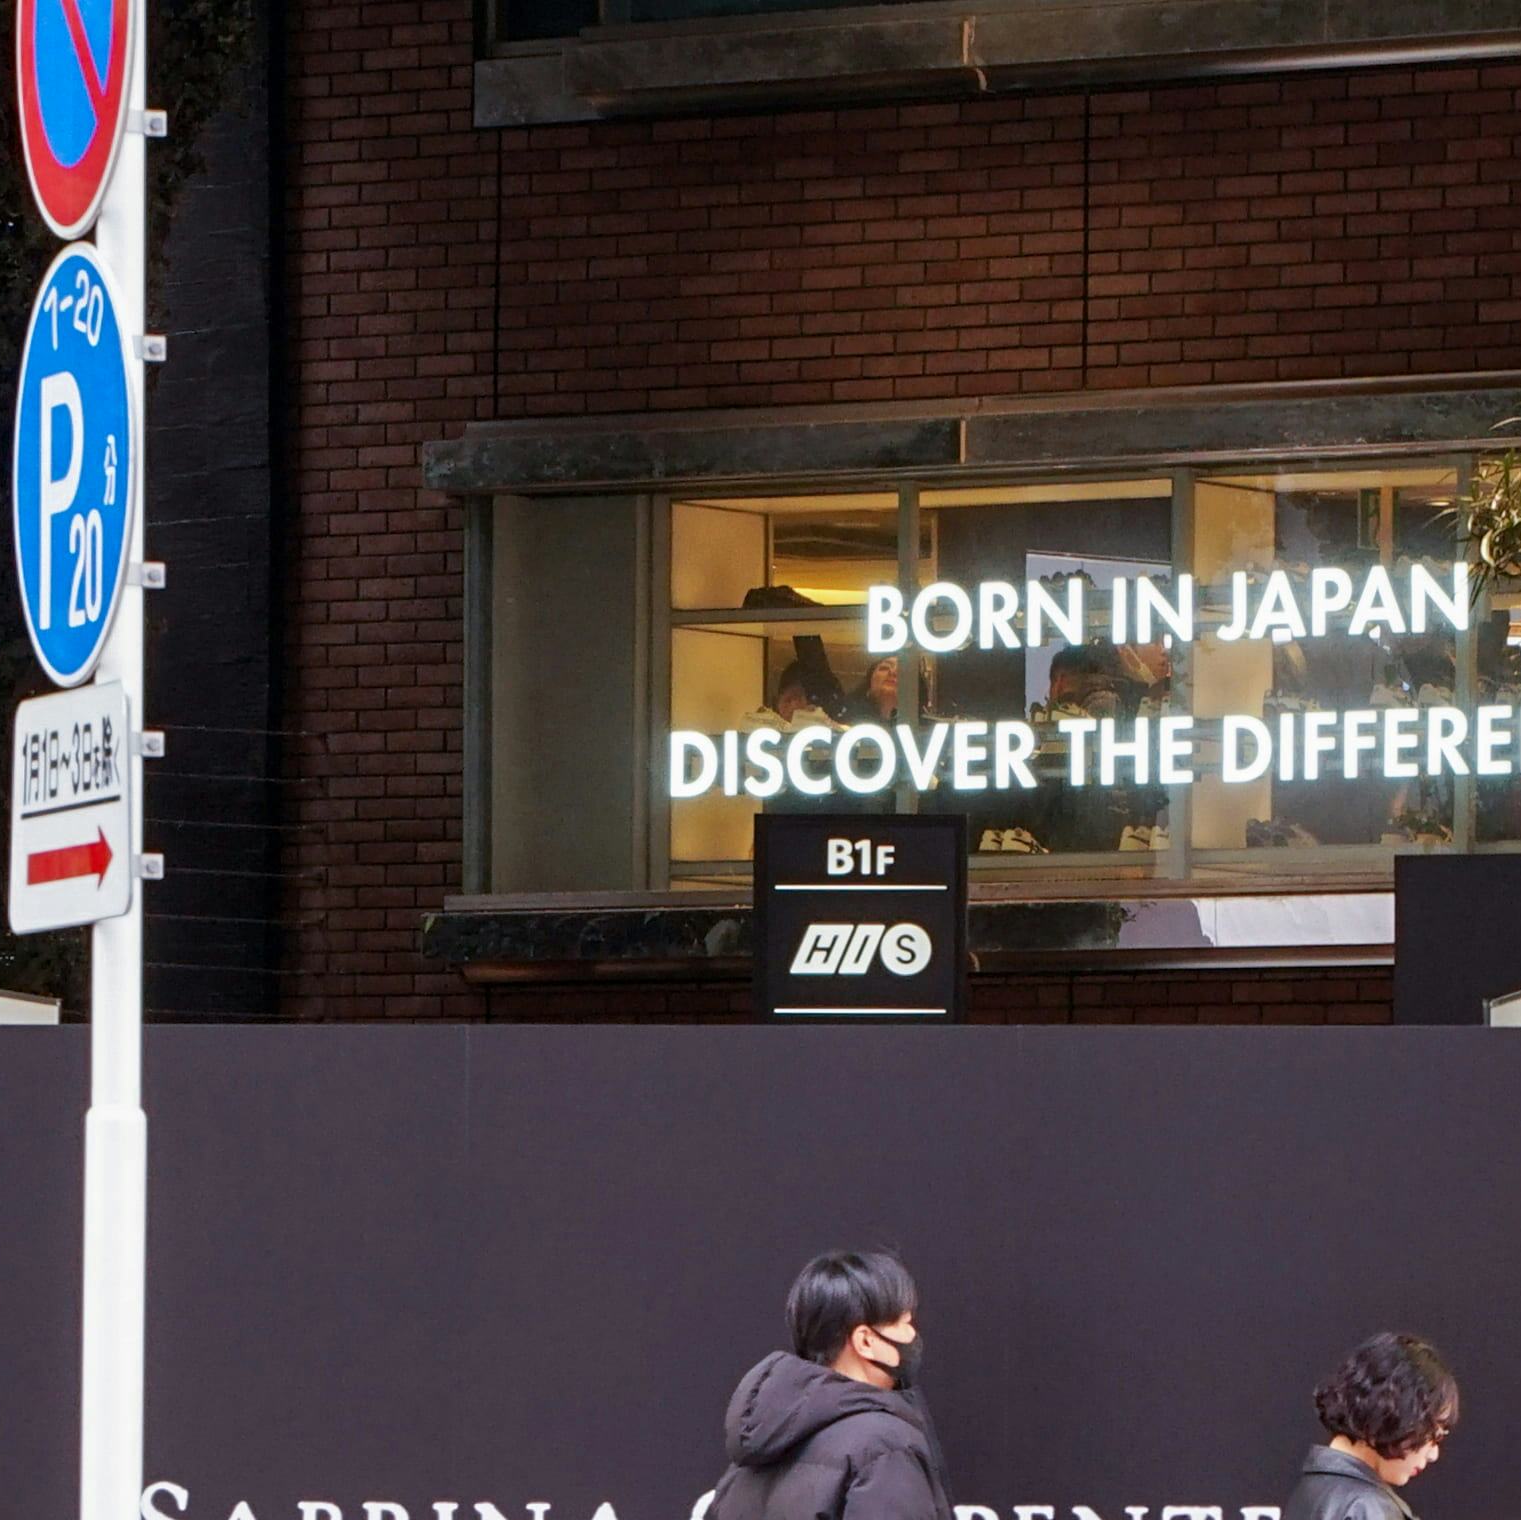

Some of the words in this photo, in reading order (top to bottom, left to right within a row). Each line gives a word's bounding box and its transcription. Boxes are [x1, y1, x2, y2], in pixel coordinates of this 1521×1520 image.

[40, 371, 85, 630] P
[68, 511, 104, 629] 20
[867, 578, 1082, 654] BORN
[1112, 573, 1193, 645] IN
[1215, 562, 1471, 642] JAPAN
[669, 716, 1036, 798] DISCOVER
[1060, 715, 1194, 786] THE
[827, 837, 895, 877] B1F
[790, 921, 933, 977] HIS
